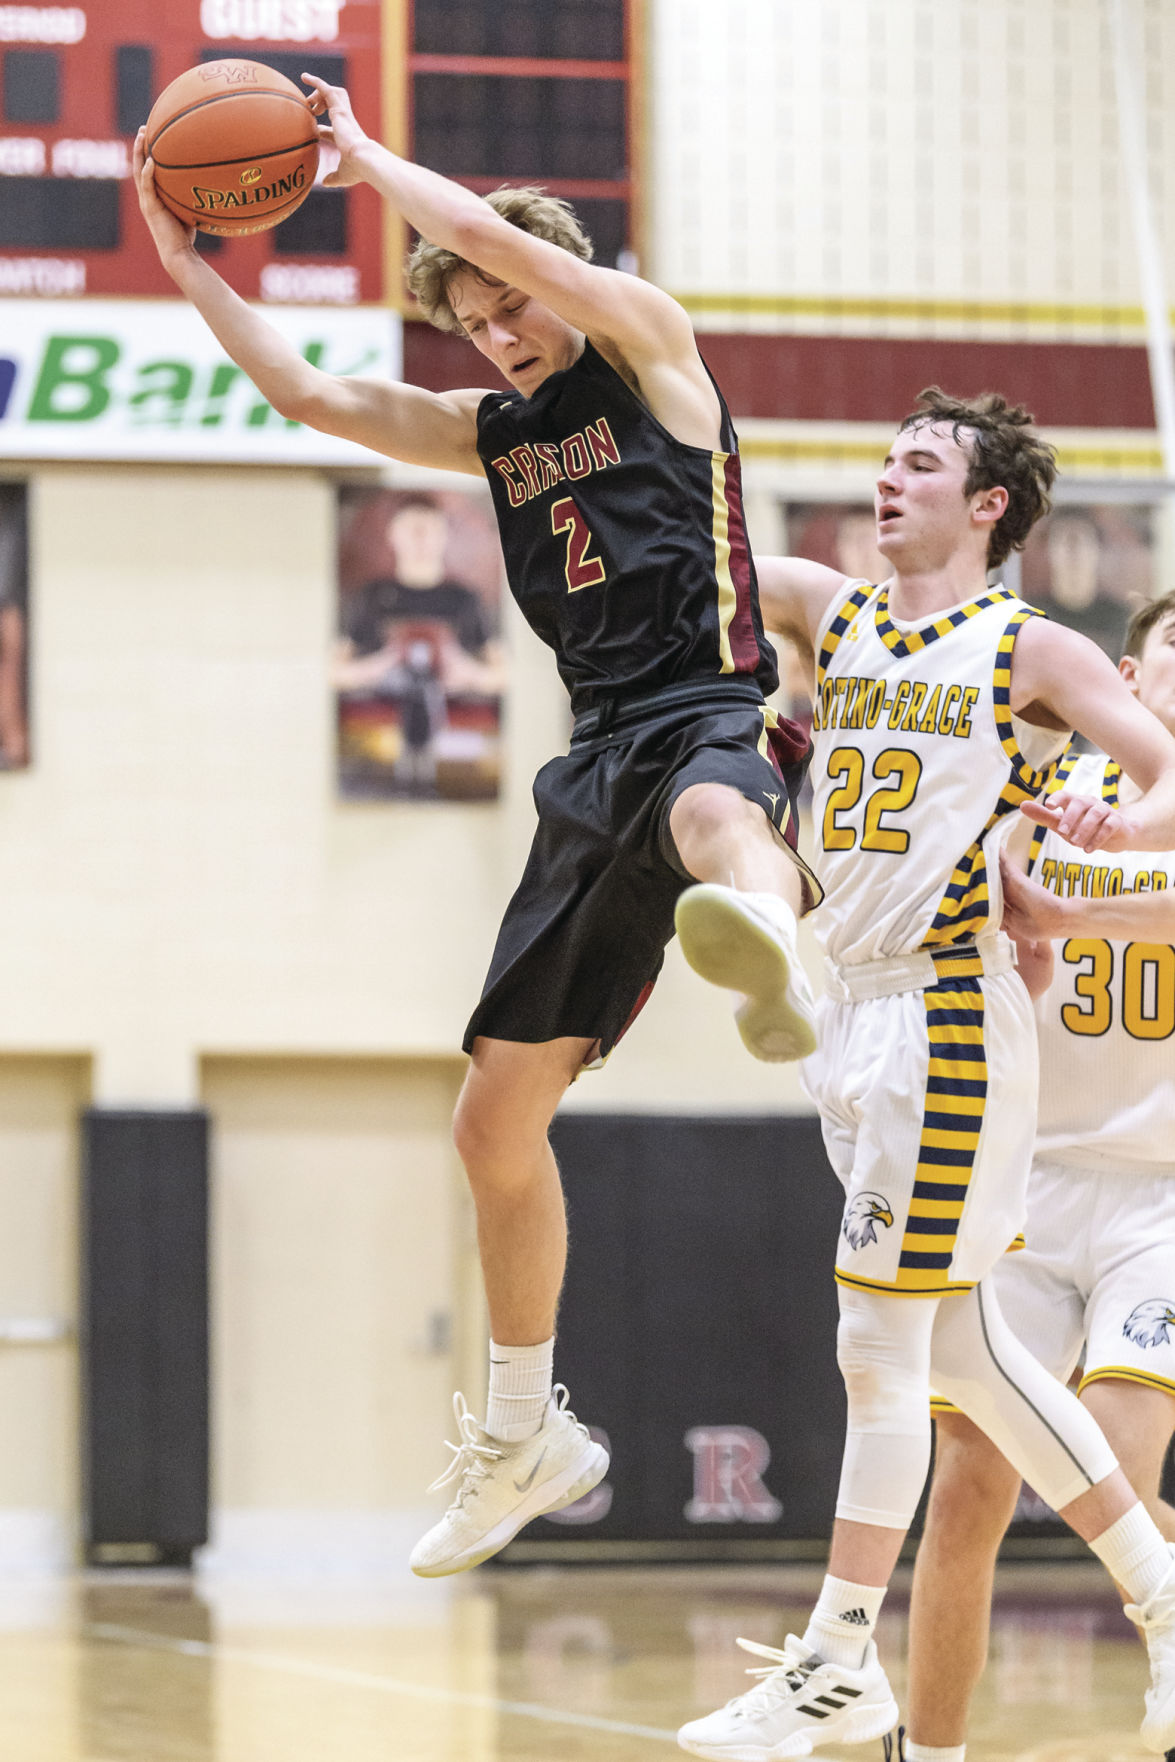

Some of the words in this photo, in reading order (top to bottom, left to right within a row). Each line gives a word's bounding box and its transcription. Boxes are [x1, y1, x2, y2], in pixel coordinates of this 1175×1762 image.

[192, 164, 305, 210] SPALDING
[551, 496, 606, 594] 2
[812, 676, 980, 738] OTINO-GRACE
[823, 746, 923, 854] 22
[1061, 938, 1175, 1041] 30
